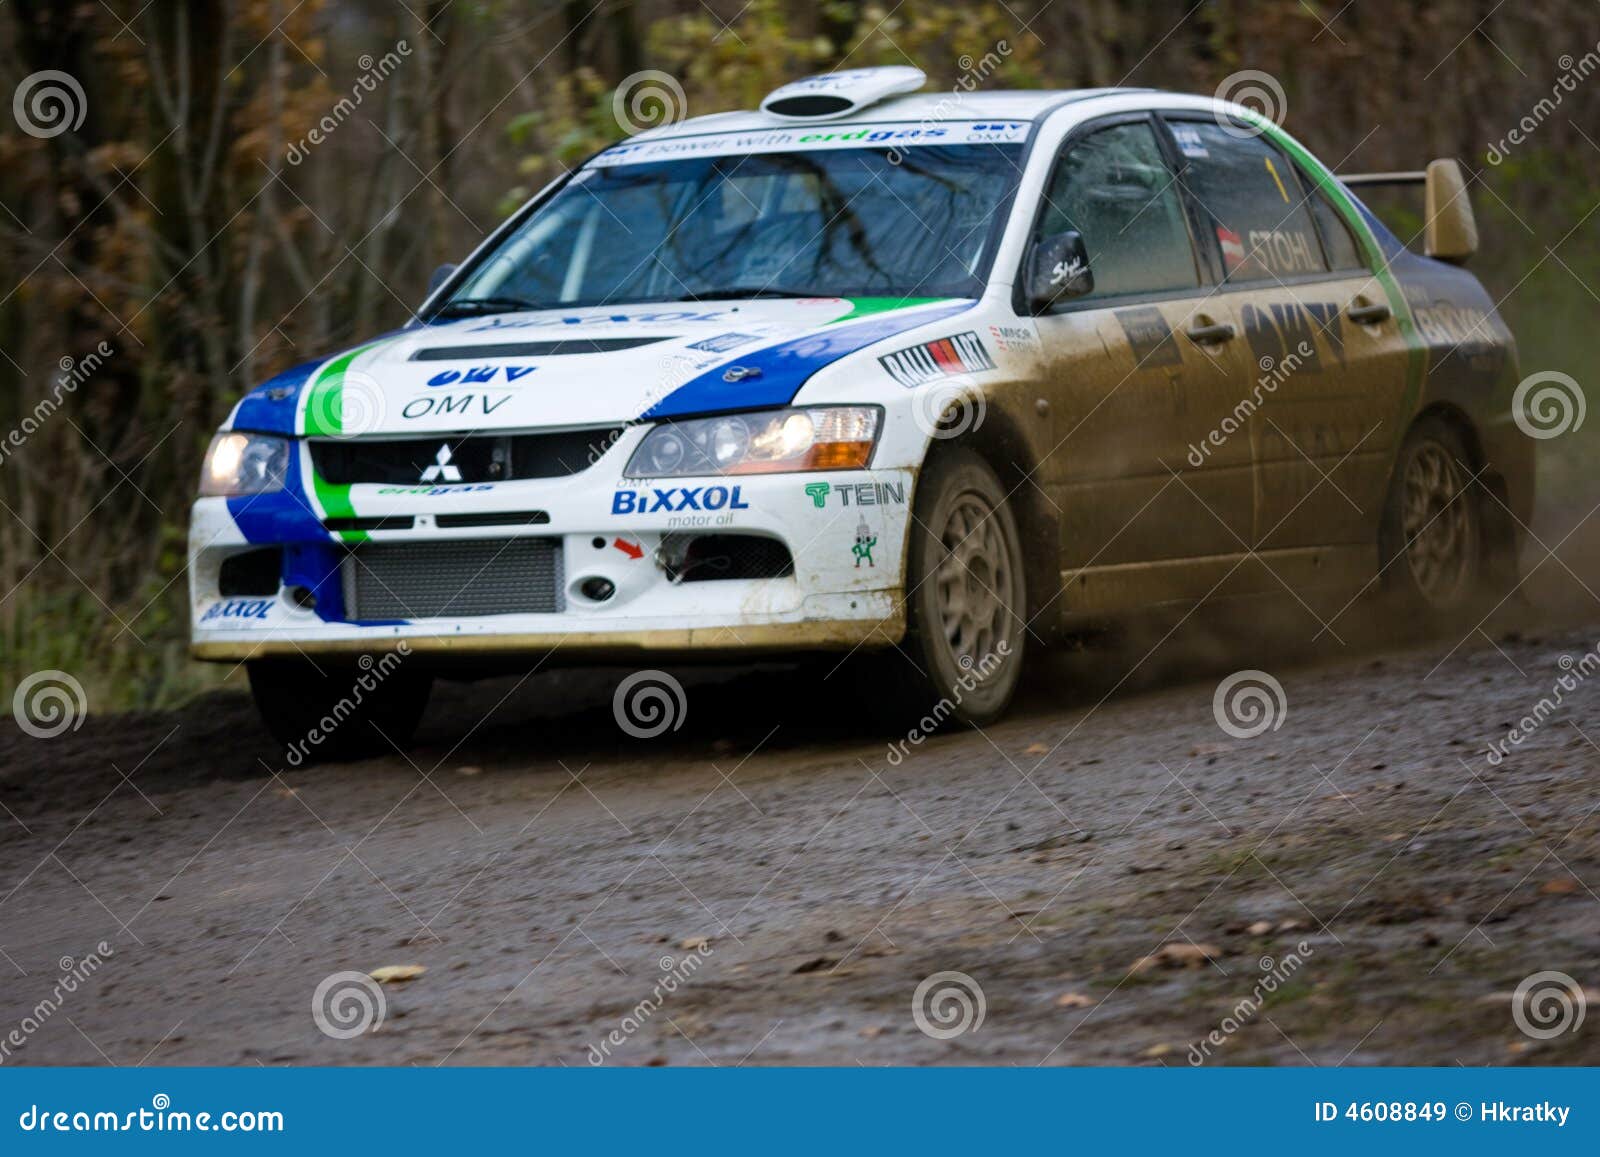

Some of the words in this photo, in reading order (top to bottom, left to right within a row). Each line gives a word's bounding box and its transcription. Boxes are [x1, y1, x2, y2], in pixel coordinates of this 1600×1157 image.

[799, 126, 949, 144] erdgas
[1249, 230, 1321, 273] STOHL
[402, 394, 512, 419] OMV
[834, 483, 905, 506] TEIN
[667, 515, 712, 528] motor
[716, 512, 735, 525] oil
